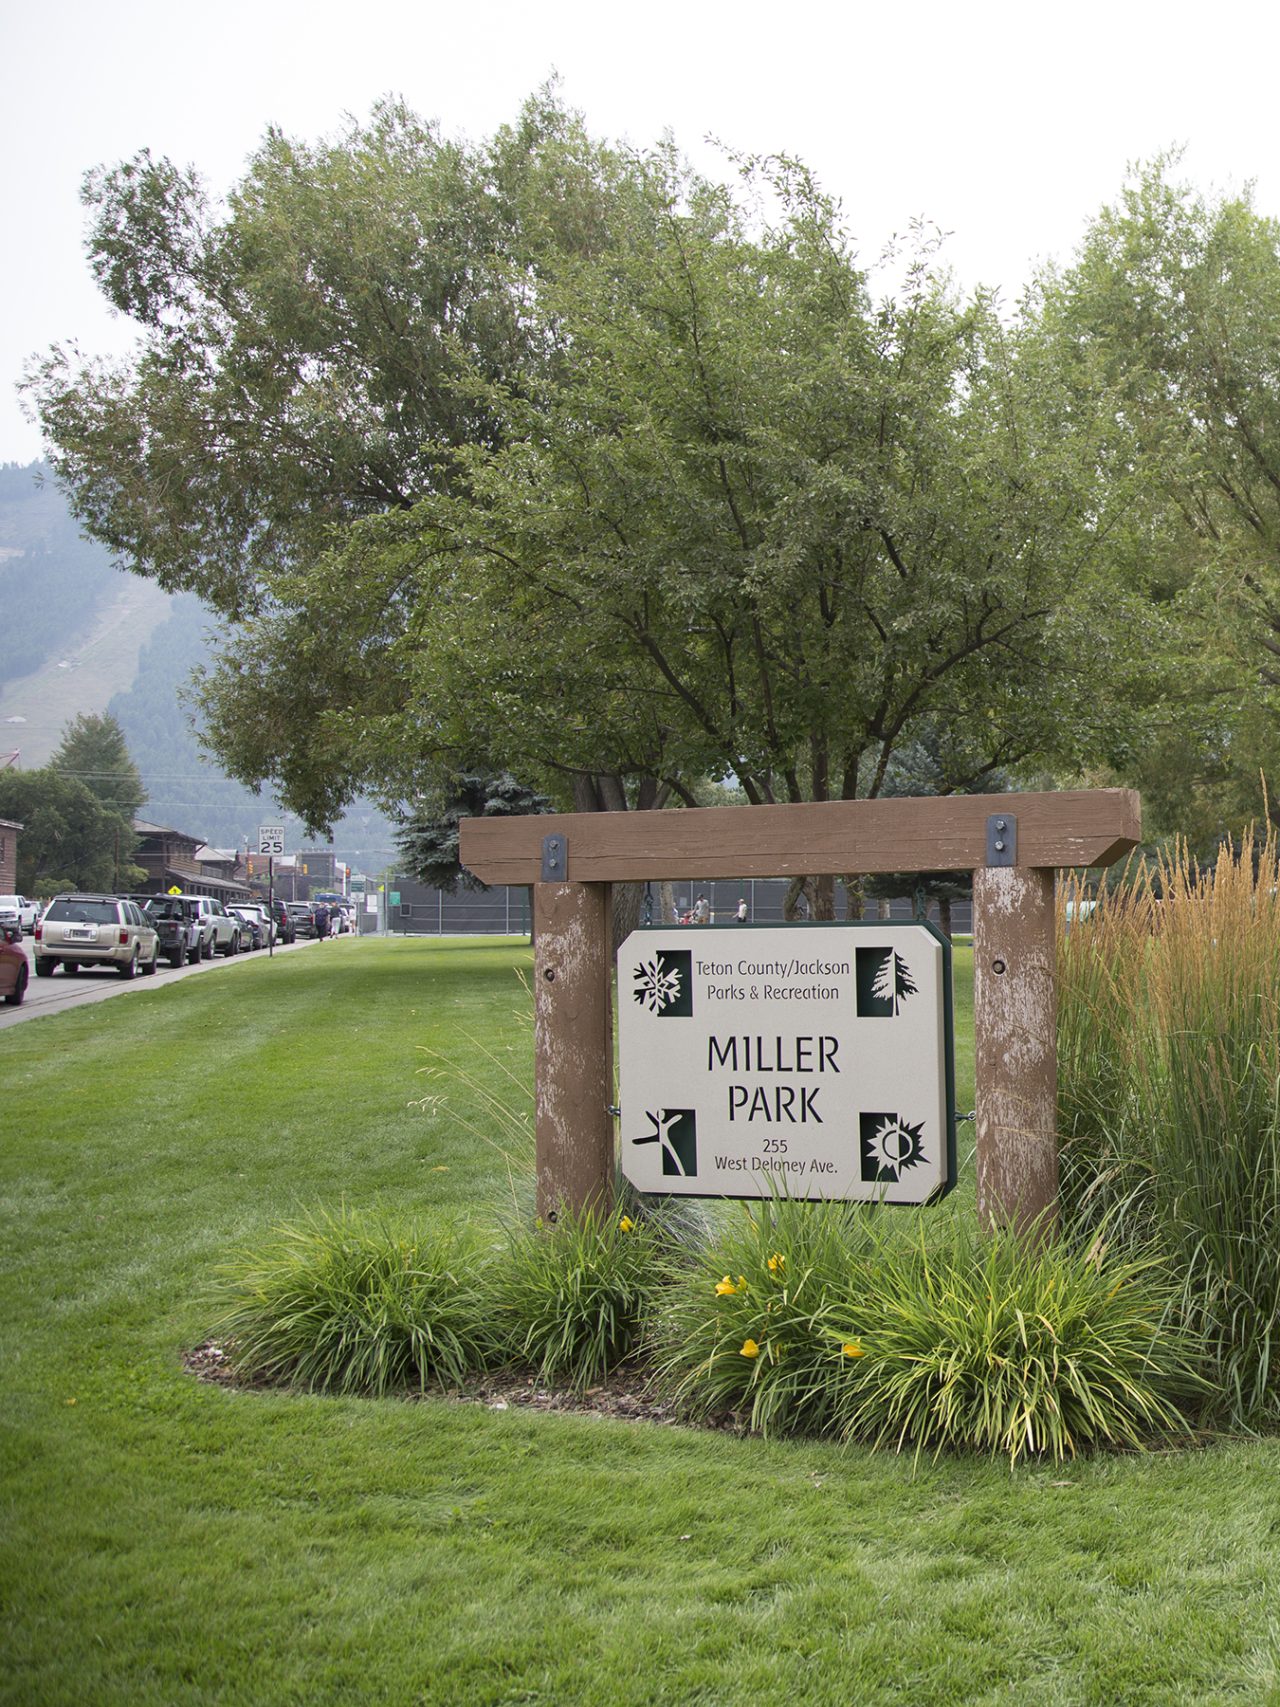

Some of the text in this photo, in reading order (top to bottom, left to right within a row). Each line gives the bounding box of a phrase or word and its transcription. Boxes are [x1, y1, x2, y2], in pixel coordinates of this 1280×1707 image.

[261, 842, 283, 853] 25
[696, 959, 850, 978] Teton County/Jackson
[707, 984, 839, 1000] Parks & Recreation
[708, 1036, 841, 1073] MILLER
[728, 1086, 824, 1123] PARK
[763, 1139, 788, 1153] 255
[715, 1156, 838, 1175] West Deloney Ave.
